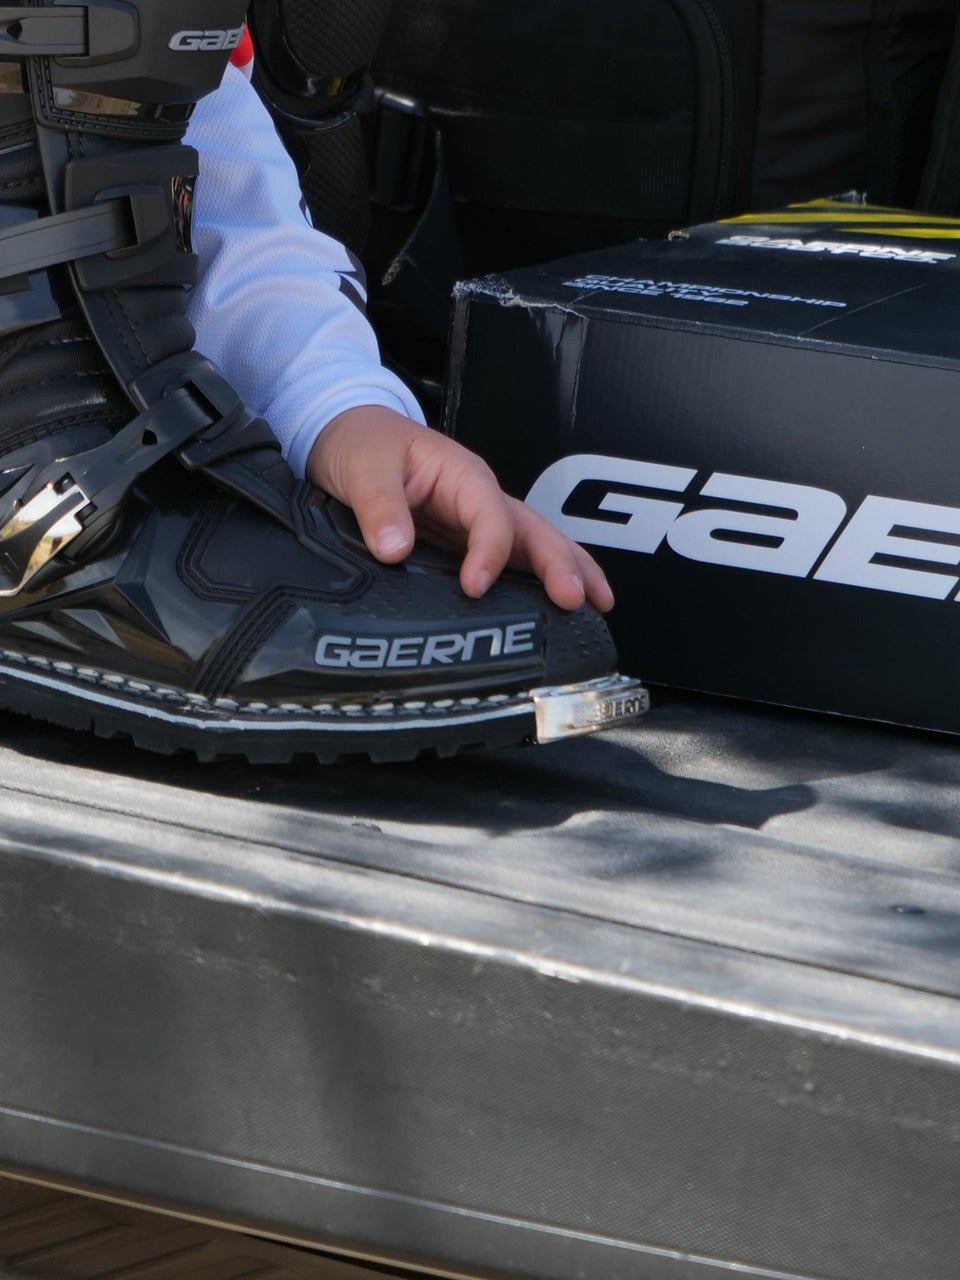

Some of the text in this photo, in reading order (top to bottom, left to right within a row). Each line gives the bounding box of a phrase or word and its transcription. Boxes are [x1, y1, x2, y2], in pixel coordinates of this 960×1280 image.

[562, 281, 664, 297] SINCE
[585, 274, 847, 308] CHAMPIONSHIP
[525, 453, 960, 603] GAE
[315, 622, 535, 668] GAERNE
